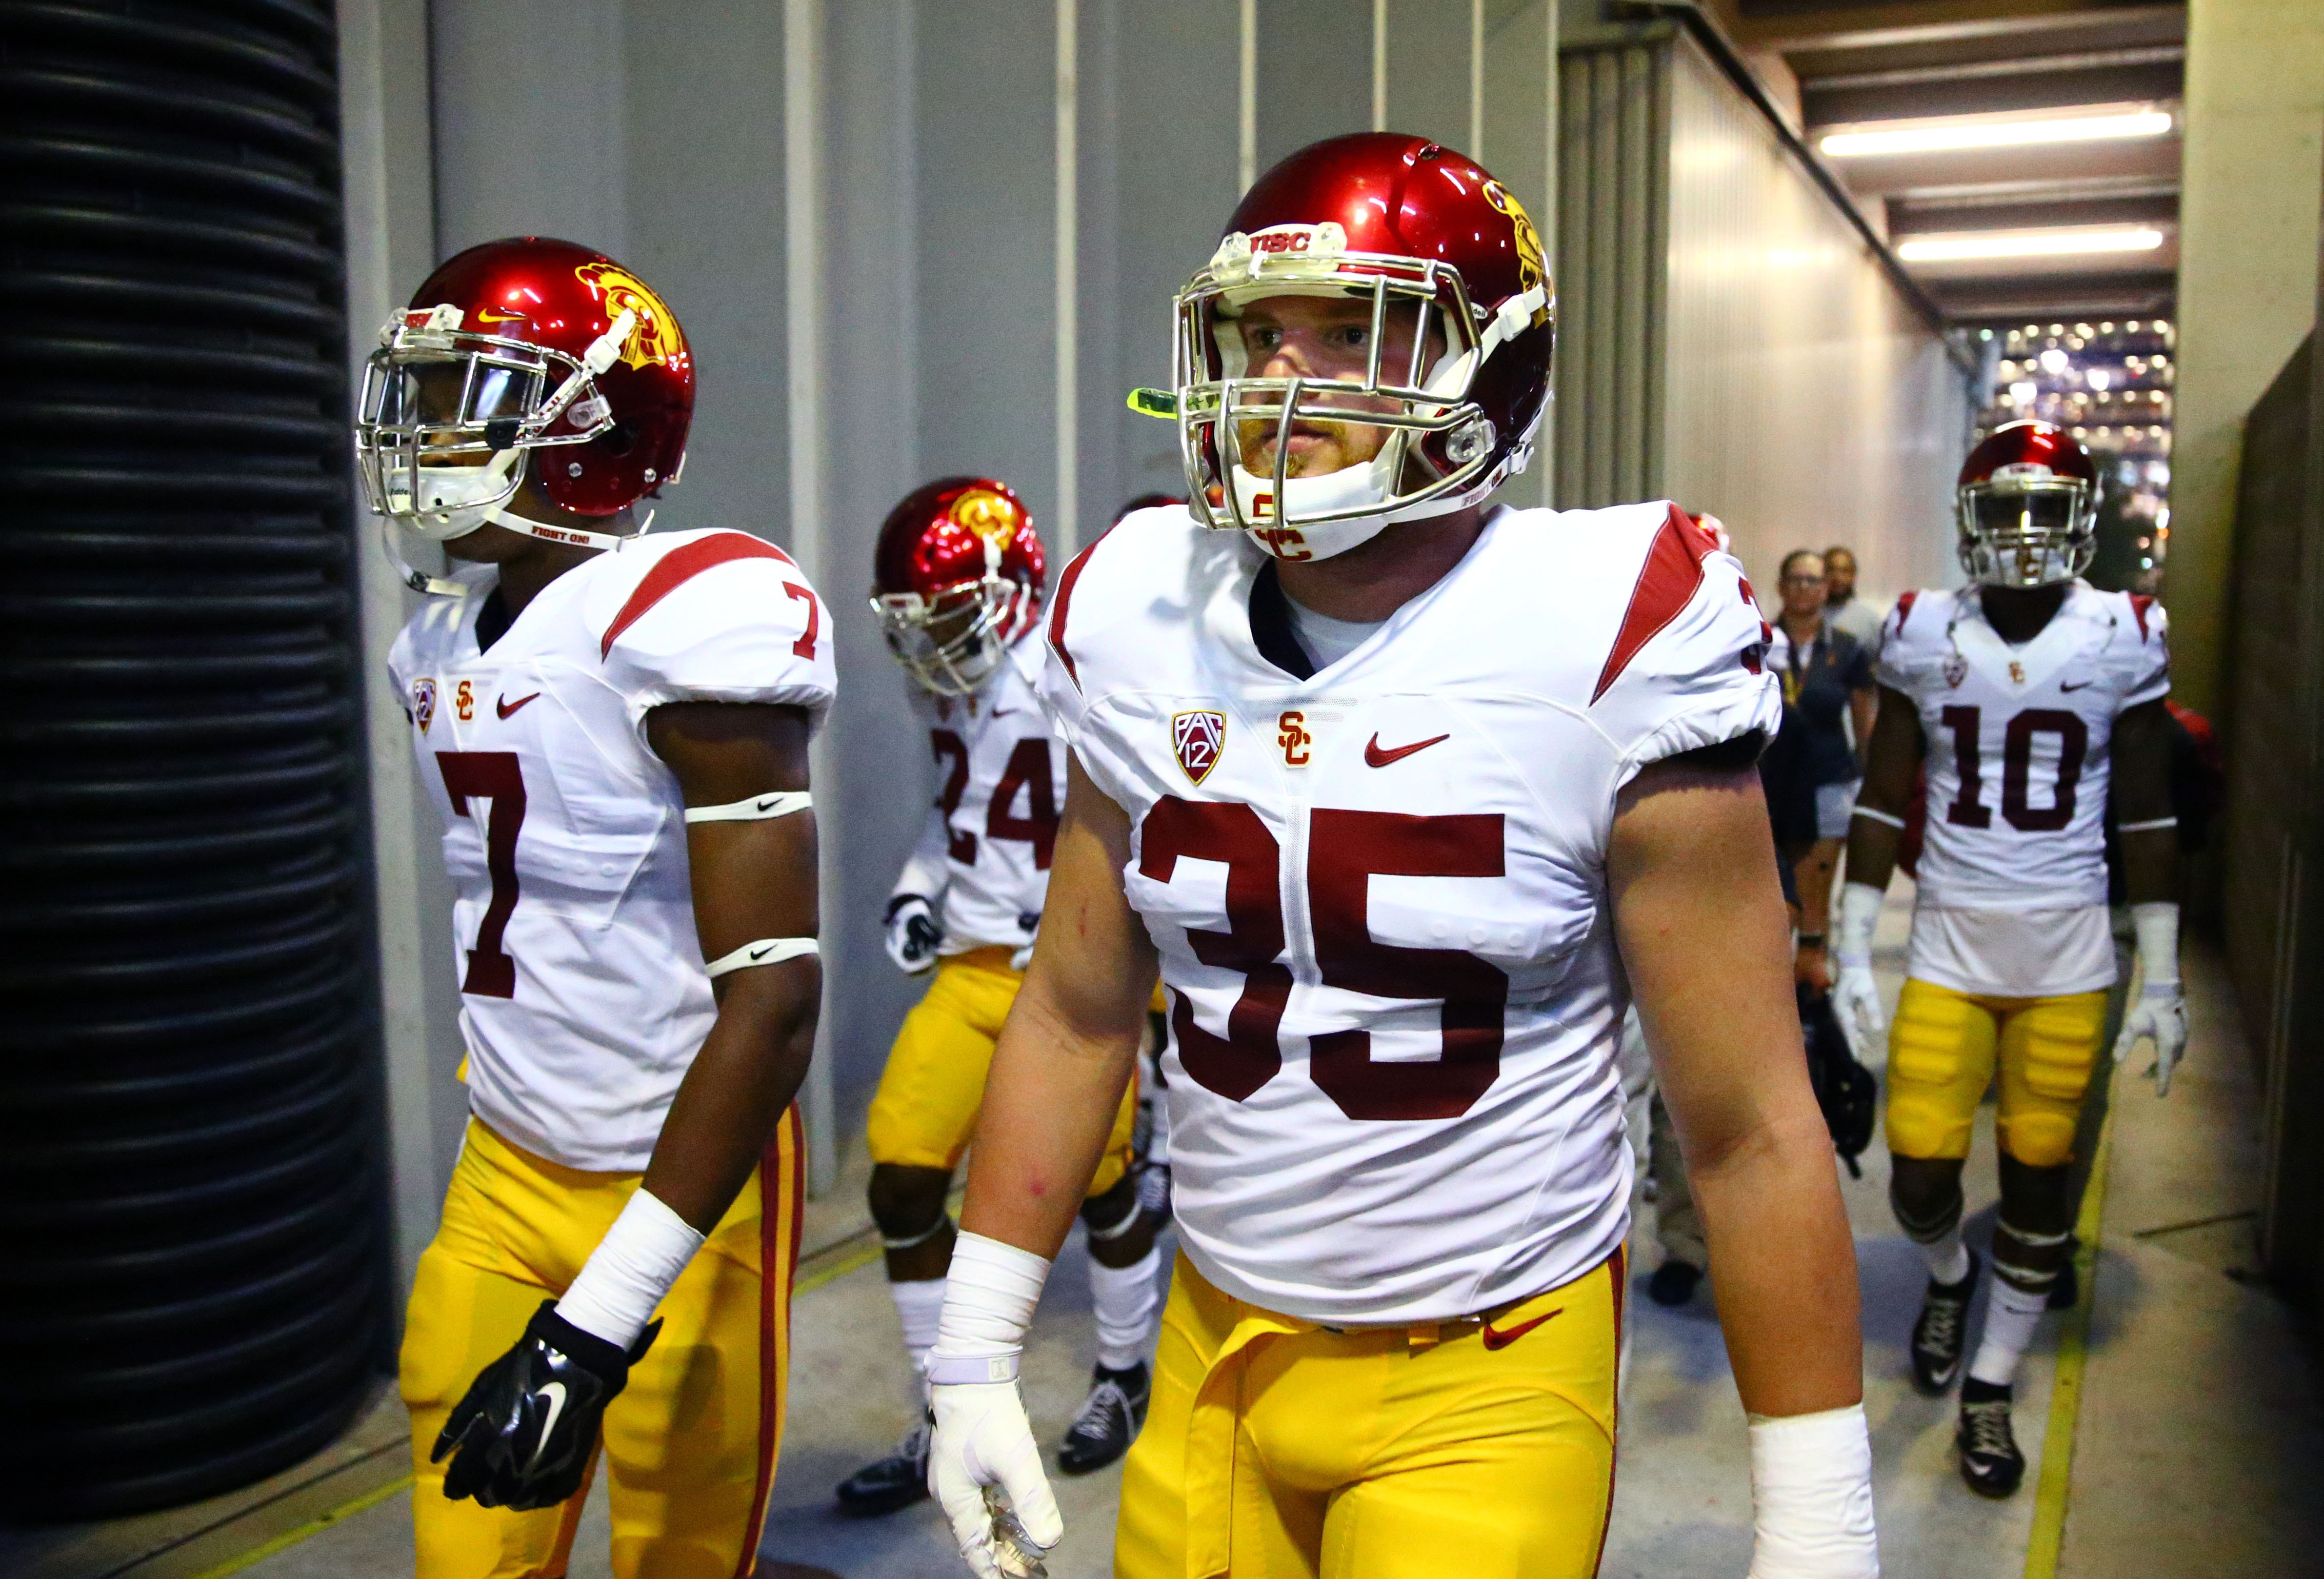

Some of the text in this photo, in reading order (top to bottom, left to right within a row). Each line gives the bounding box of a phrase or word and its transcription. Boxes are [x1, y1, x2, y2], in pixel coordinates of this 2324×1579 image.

[1250, 232, 1311, 254] USC
[531, 526, 590, 544] FIGHT ON!
[782, 580, 819, 661] 7
[456, 680, 474, 721] SC
[1174, 712, 1223, 755] PAC
[1185, 741, 1210, 768] 12
[1278, 711, 1311, 765] SC
[1941, 705, 2087, 832] 10
[930, 728, 1063, 870] 24
[435, 751, 527, 999] 7
[1138, 794, 1509, 1121] 35
